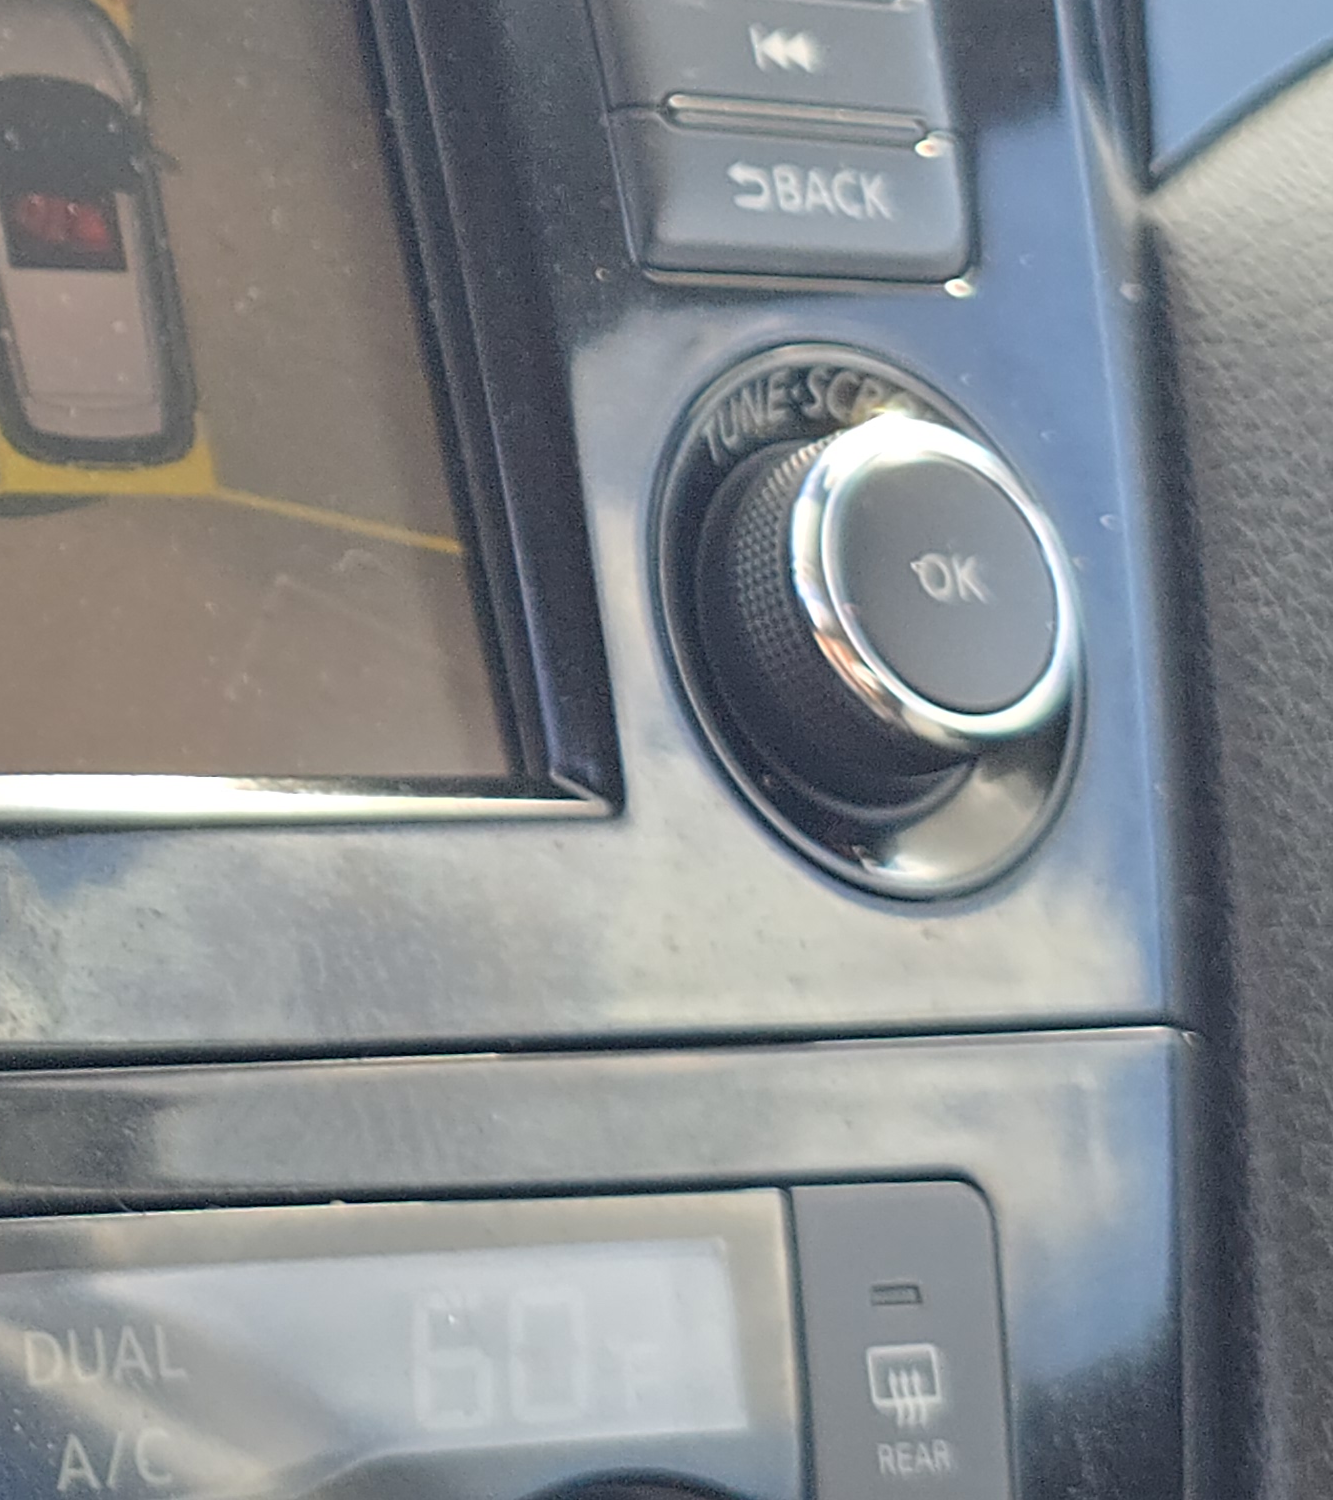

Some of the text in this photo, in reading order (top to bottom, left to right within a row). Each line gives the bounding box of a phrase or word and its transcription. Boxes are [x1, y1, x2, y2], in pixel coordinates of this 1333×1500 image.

[770, 161, 895, 221] BACK
[915, 552, 988, 603] OK
[24, 1325, 188, 1387] DUAL
[57, 1426, 174, 1491] A/C
[876, 1439, 952, 1476] REAR
